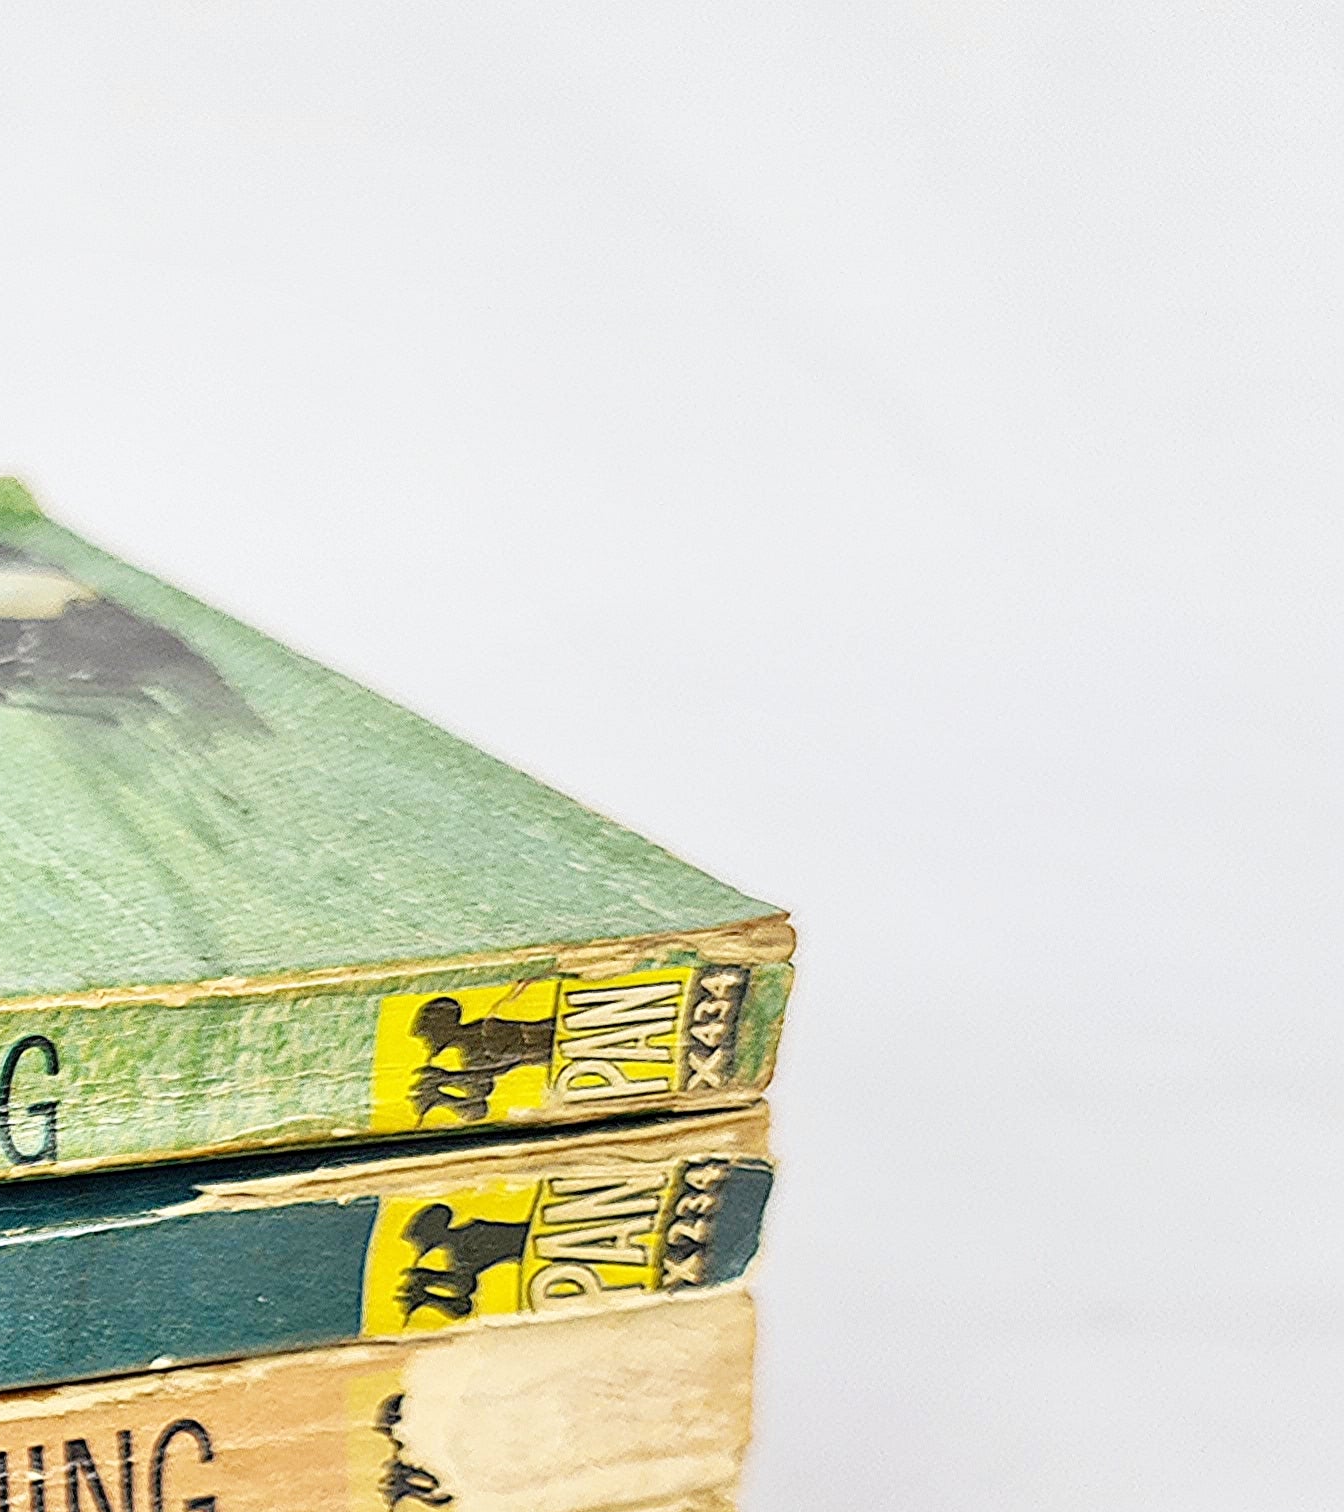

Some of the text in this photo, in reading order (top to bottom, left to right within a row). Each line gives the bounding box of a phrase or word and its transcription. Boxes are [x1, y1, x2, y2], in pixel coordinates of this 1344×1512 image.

[554, 980, 683, 1104] PAN
[684, 969, 746, 1092] X434
[528, 1172, 669, 1311] PAN
